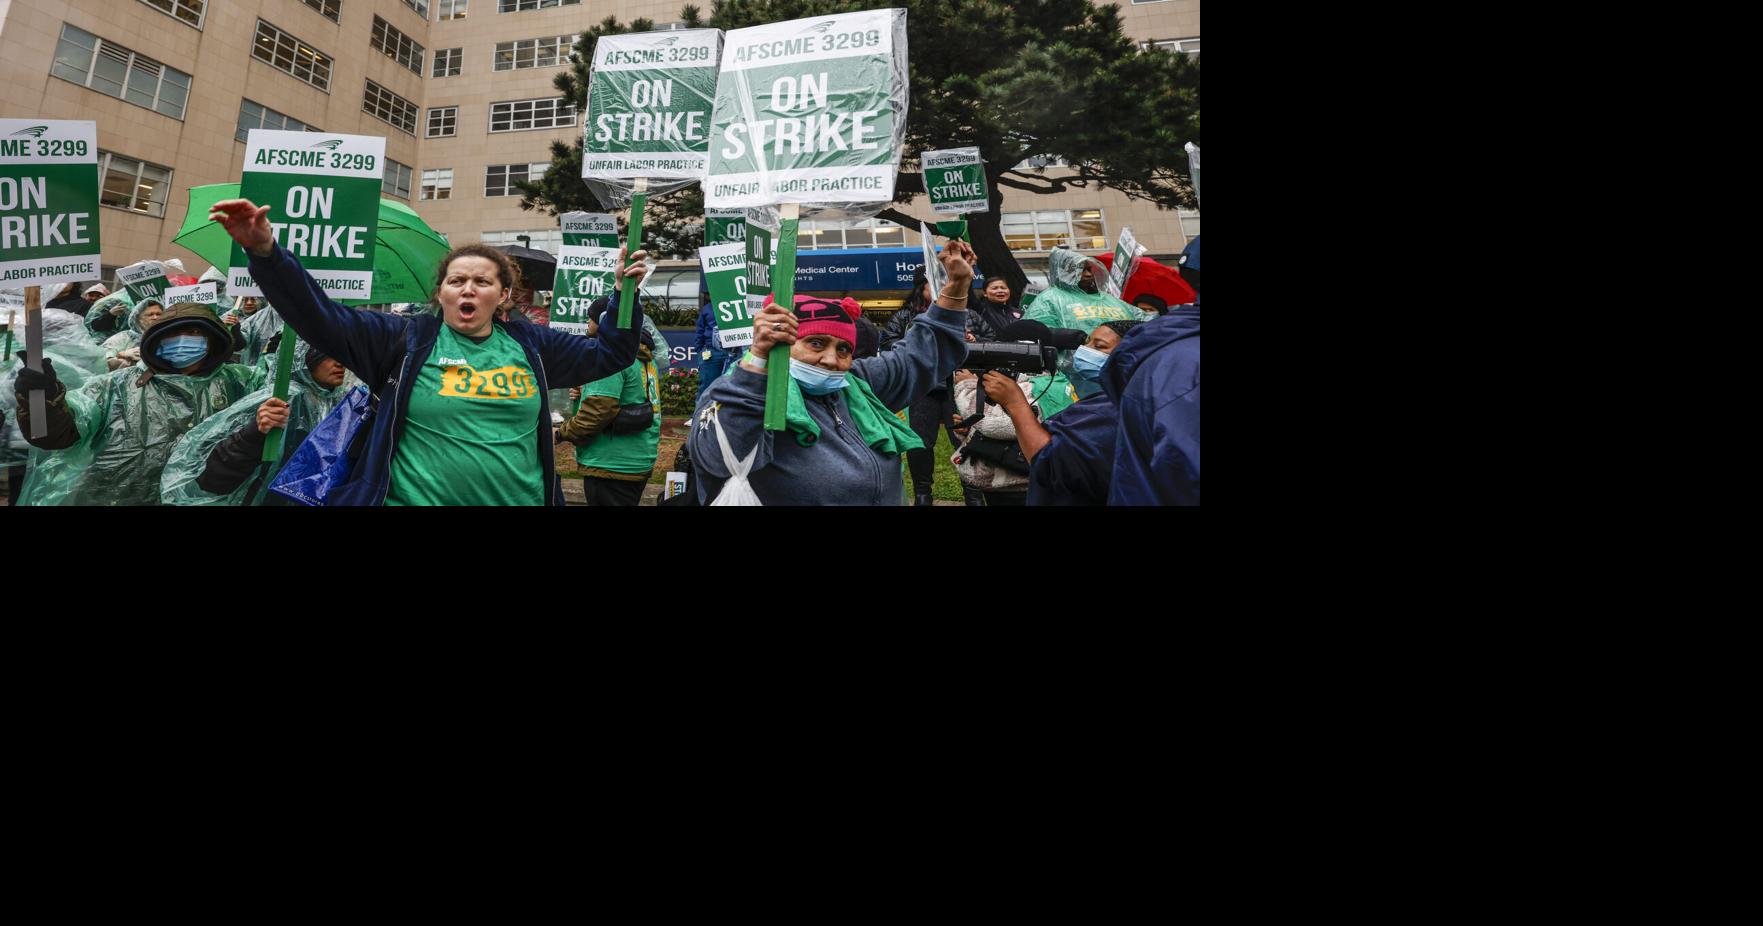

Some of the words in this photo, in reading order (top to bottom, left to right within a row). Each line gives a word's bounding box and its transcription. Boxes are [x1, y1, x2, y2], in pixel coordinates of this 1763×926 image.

[604, 49, 664, 65] AFSCME
[668, 46, 709, 62] 3299
[734, 36, 815, 63] AFSCME
[821, 29, 880, 52] 3299
[631, 79, 672, 108] ON
[771, 72, 828, 113] ON
[594, 111, 705, 142] STRIKE
[721, 110, 879, 160] STRIKE
[37, 139, 88, 157] 3299
[254, 148, 327, 168] AFSCME
[330, 152, 376, 171] 3299
[589, 160, 622, 170] UNFAIR
[657, 159, 704, 170] PRACTICE
[714, 182, 760, 198] UNFAIR
[773, 179, 808, 193] ABOR
[811, 176, 883, 192] PRACTICE
[943, 170, 964, 184] ON
[0, 176, 47, 211] ON
[932, 182, 982, 199] STRIKE
[285, 185, 334, 220] ON
[2, 212, 90, 249] RIKE
[565, 222, 593, 231] AFSCME
[594, 222, 614, 231] 3299
[270, 222, 368, 259] TRIKE
[753, 235, 764, 260] ON
[39, 262, 94, 277] PRACTICE
[562, 255, 599, 267] AFSCME
[828, 266, 860, 274] Center
[747, 260, 771, 288] STRIKE
[896, 274, 914, 282] 505
[140, 283, 158, 297] ON
[577, 276, 604, 296] ON
[168, 294, 195, 305] AFSCME
[196, 291, 214, 301] 3299
[724, 332, 748, 343] UNFAIR
[454, 367, 528, 397] 3299
